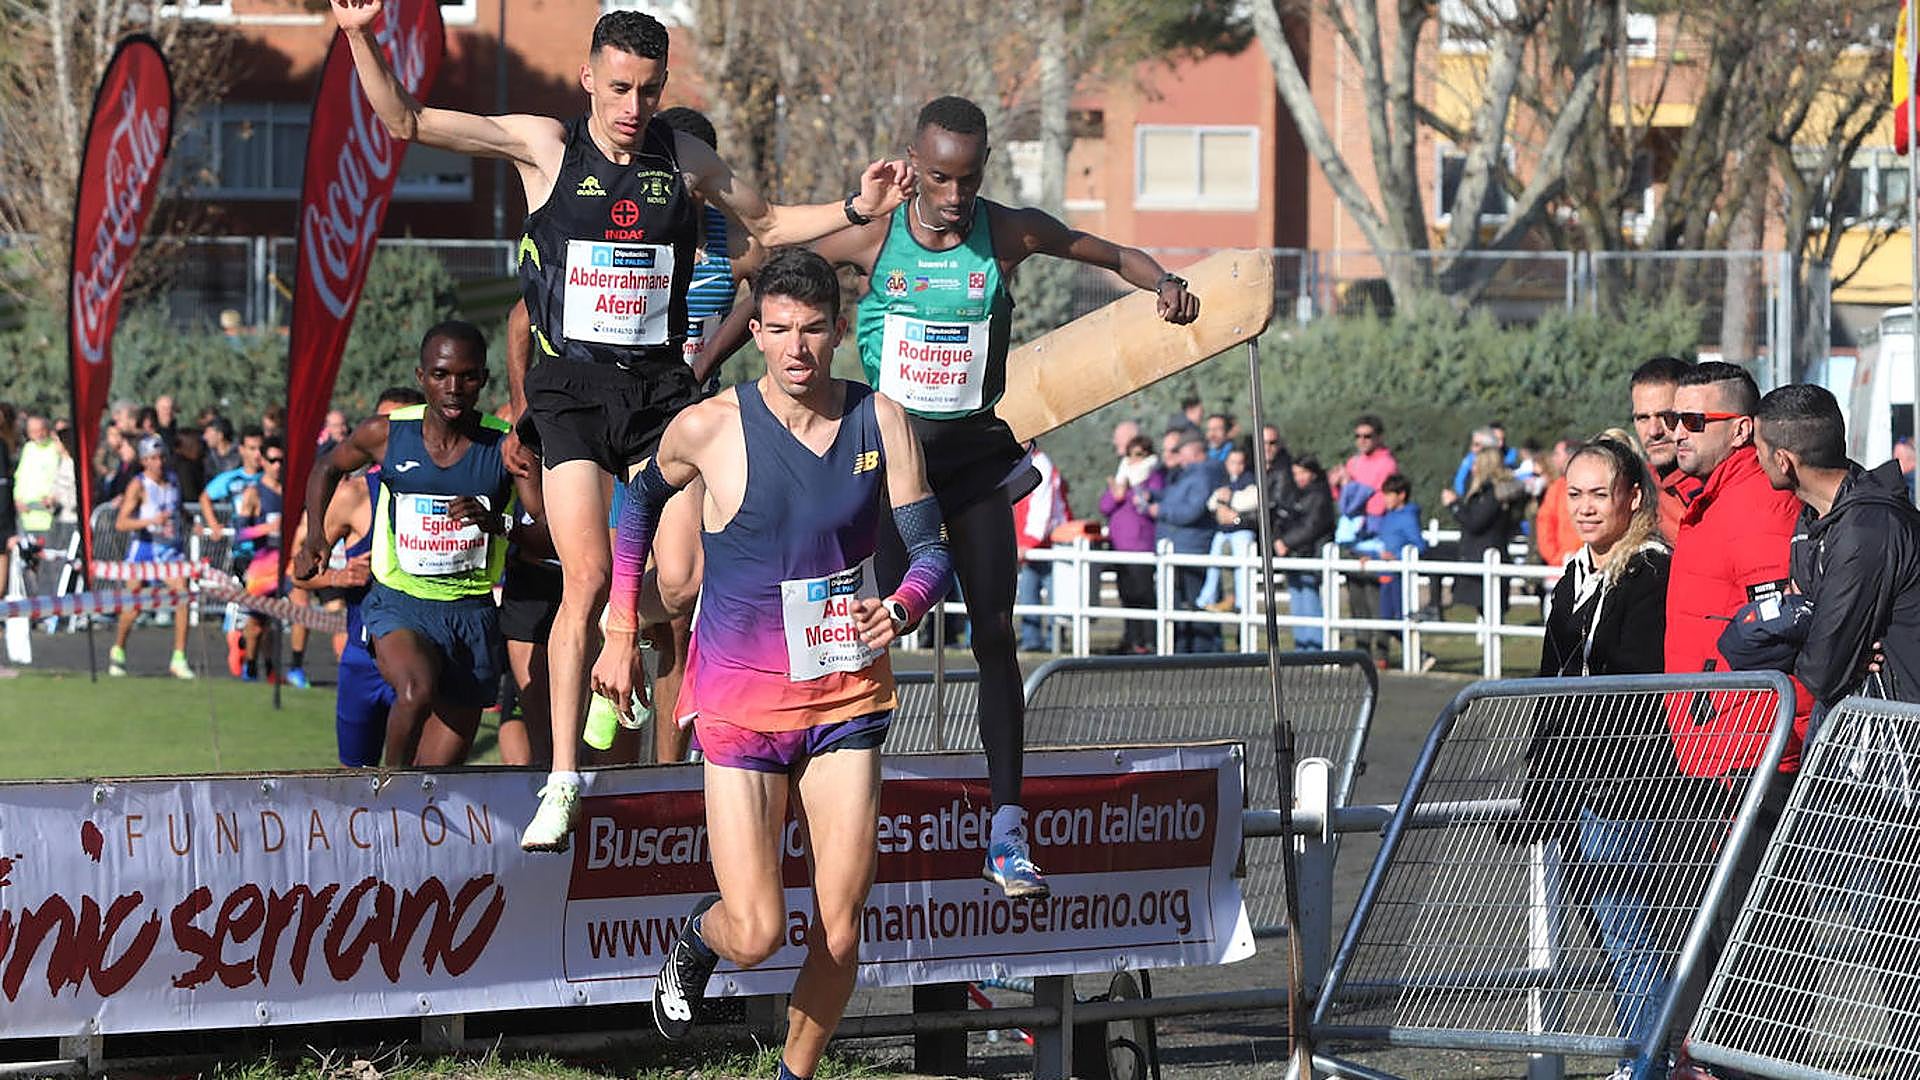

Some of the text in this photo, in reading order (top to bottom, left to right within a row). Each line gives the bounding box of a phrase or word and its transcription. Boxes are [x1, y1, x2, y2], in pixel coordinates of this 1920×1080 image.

[604, 229, 645, 241] INDAS
[569, 266, 670, 290] Abderrahmane
[594, 293, 648, 315] Aferdi
[898, 340, 973, 367] Rodrigue
[899, 363, 968, 385] Kwizera
[399, 532, 485, 552] Nduwimana
[822, 597, 849, 619] Ad
[805, 623, 859, 648] Mech
[126, 797, 493, 858] FUNDACIÓN
[1034, 806, 1093, 846] con
[1100, 793, 1206, 844] talento
[170, 873, 507, 990] serrano
